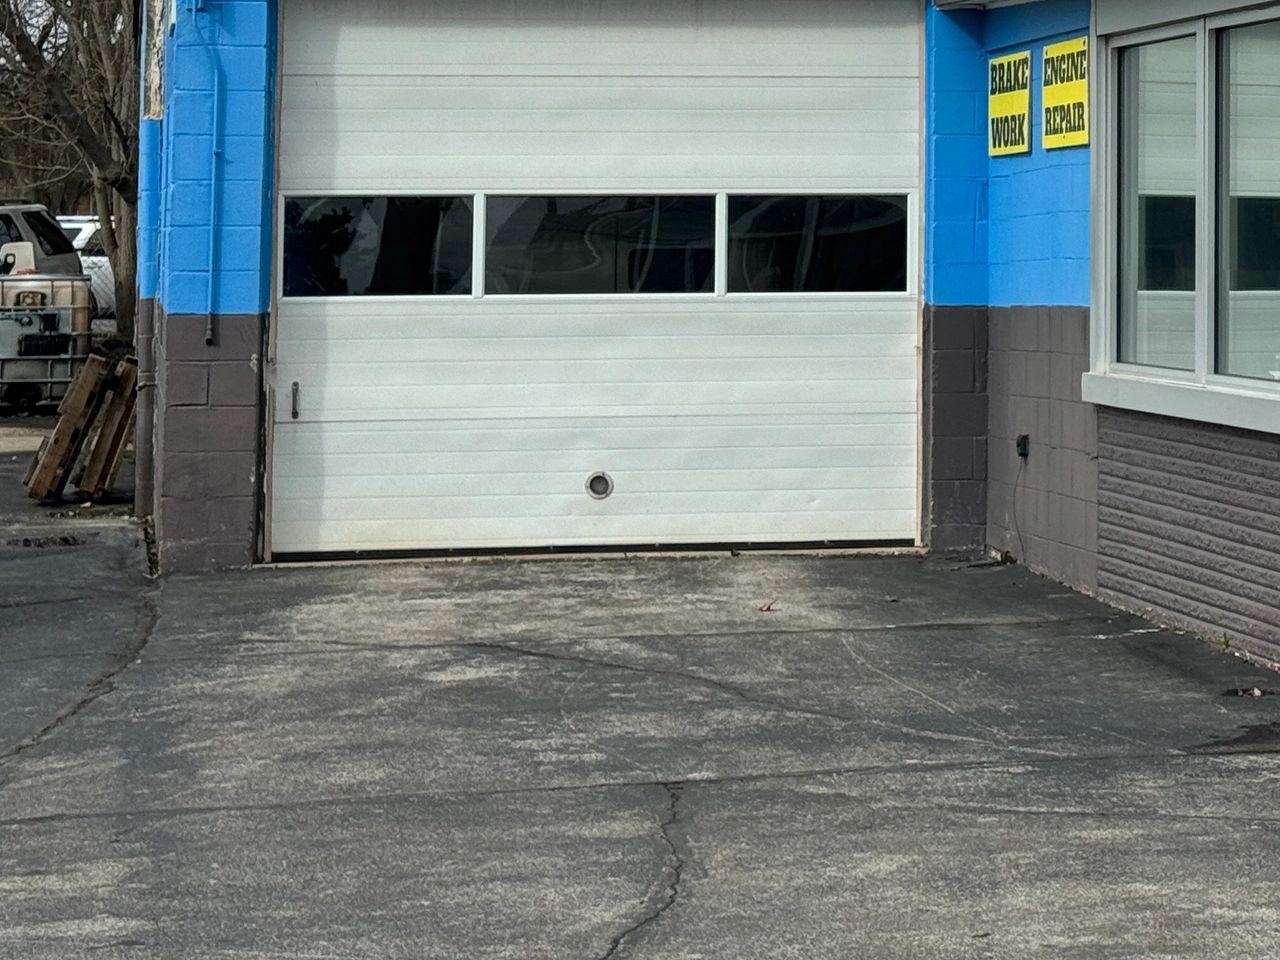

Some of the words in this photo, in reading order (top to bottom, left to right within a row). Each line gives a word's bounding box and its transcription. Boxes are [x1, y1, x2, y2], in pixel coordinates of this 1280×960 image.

[990, 58, 1029, 96] BRAKE
[1044, 49, 1087, 87] ENGINE
[992, 113, 1026, 149] WORK
[1045, 102, 1085, 136] REPAIR
